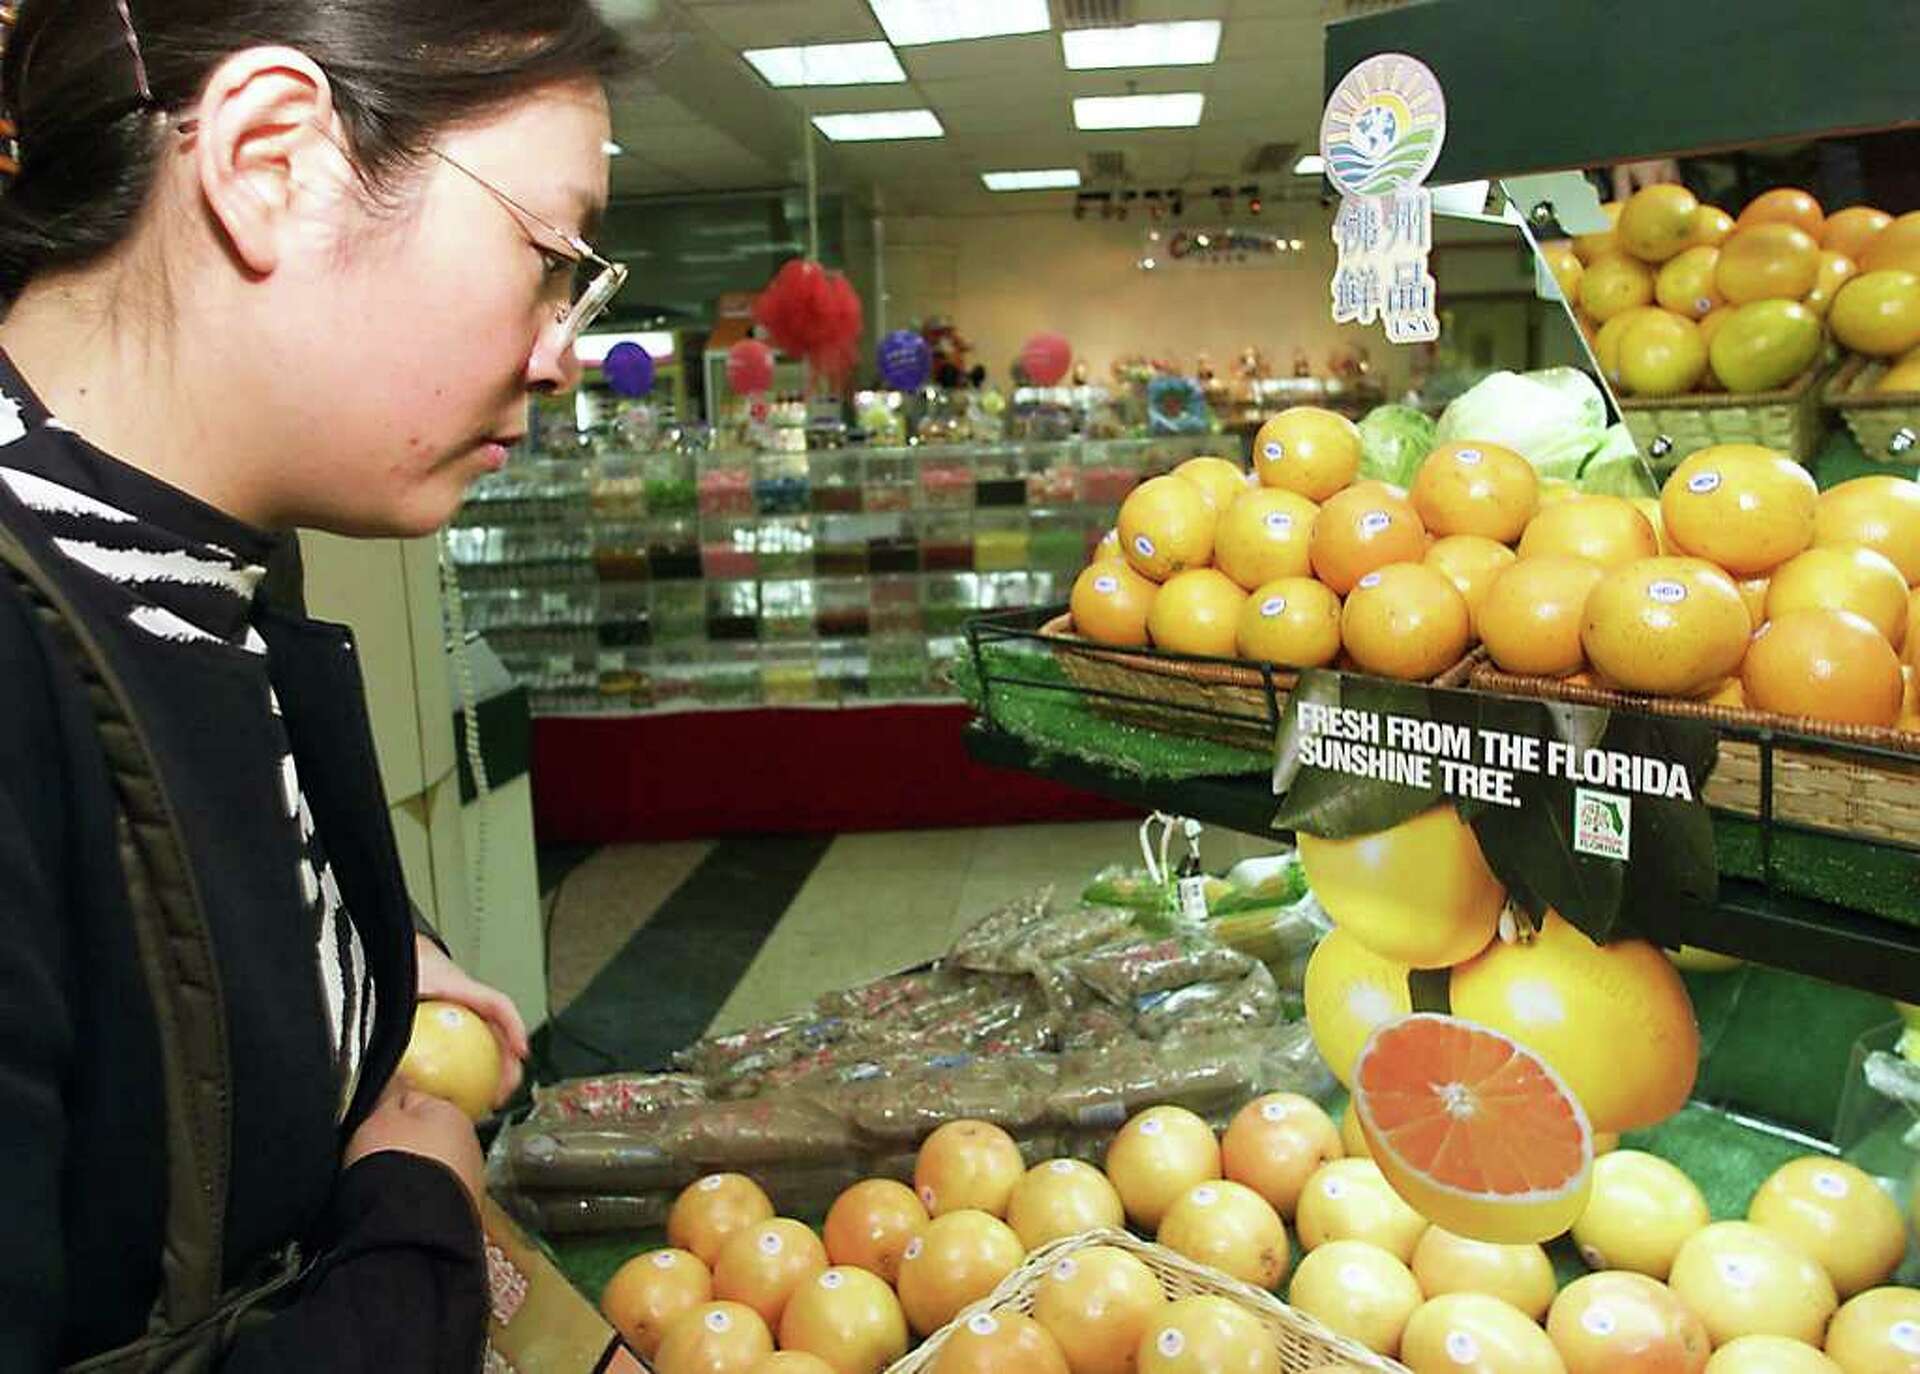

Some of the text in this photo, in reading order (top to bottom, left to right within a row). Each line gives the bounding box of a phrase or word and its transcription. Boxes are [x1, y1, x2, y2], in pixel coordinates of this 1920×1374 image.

[1297, 700, 1693, 801] FRESH FROM THE FLORIDA
[1298, 737, 1521, 808] SUNSHINE TREE.
